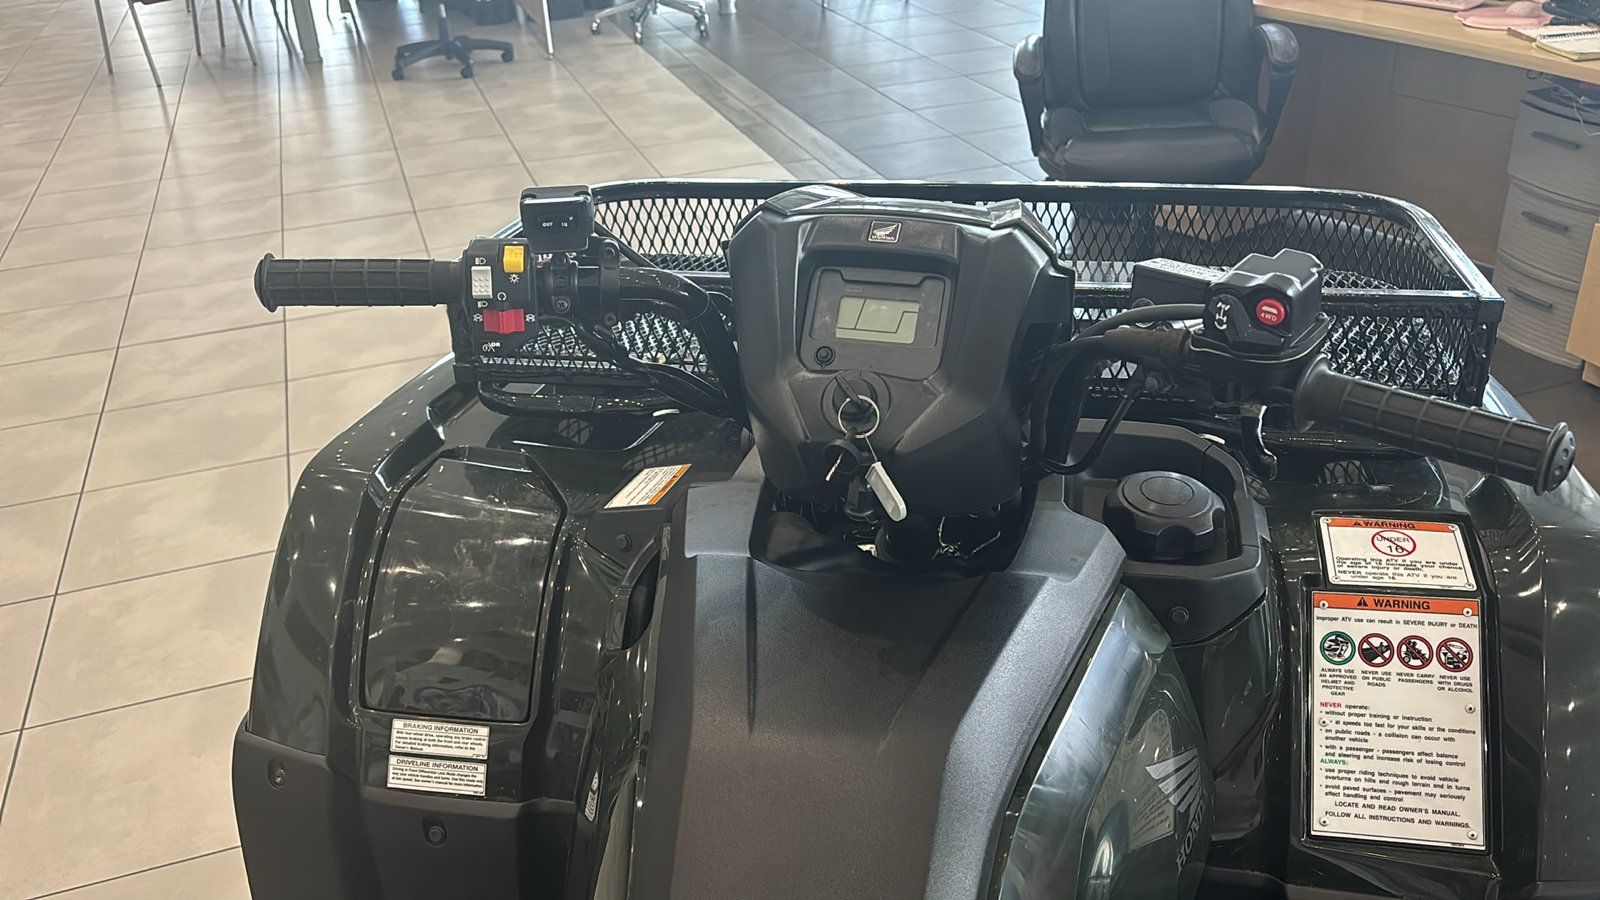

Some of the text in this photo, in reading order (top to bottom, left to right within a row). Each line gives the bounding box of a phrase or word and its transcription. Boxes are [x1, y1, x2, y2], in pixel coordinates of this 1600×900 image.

[1260, 312, 1277, 322] 4WD
[1365, 521, 1415, 529] WARNING
[1387, 545, 1404, 554] 16
[1373, 598, 1430, 610] WARNING
[434, 726, 478, 734] INFORMATION
[397, 759, 478, 771] DRIVELINE INFORMATION
[1369, 815, 1415, 824] INSTRUCTIONS
